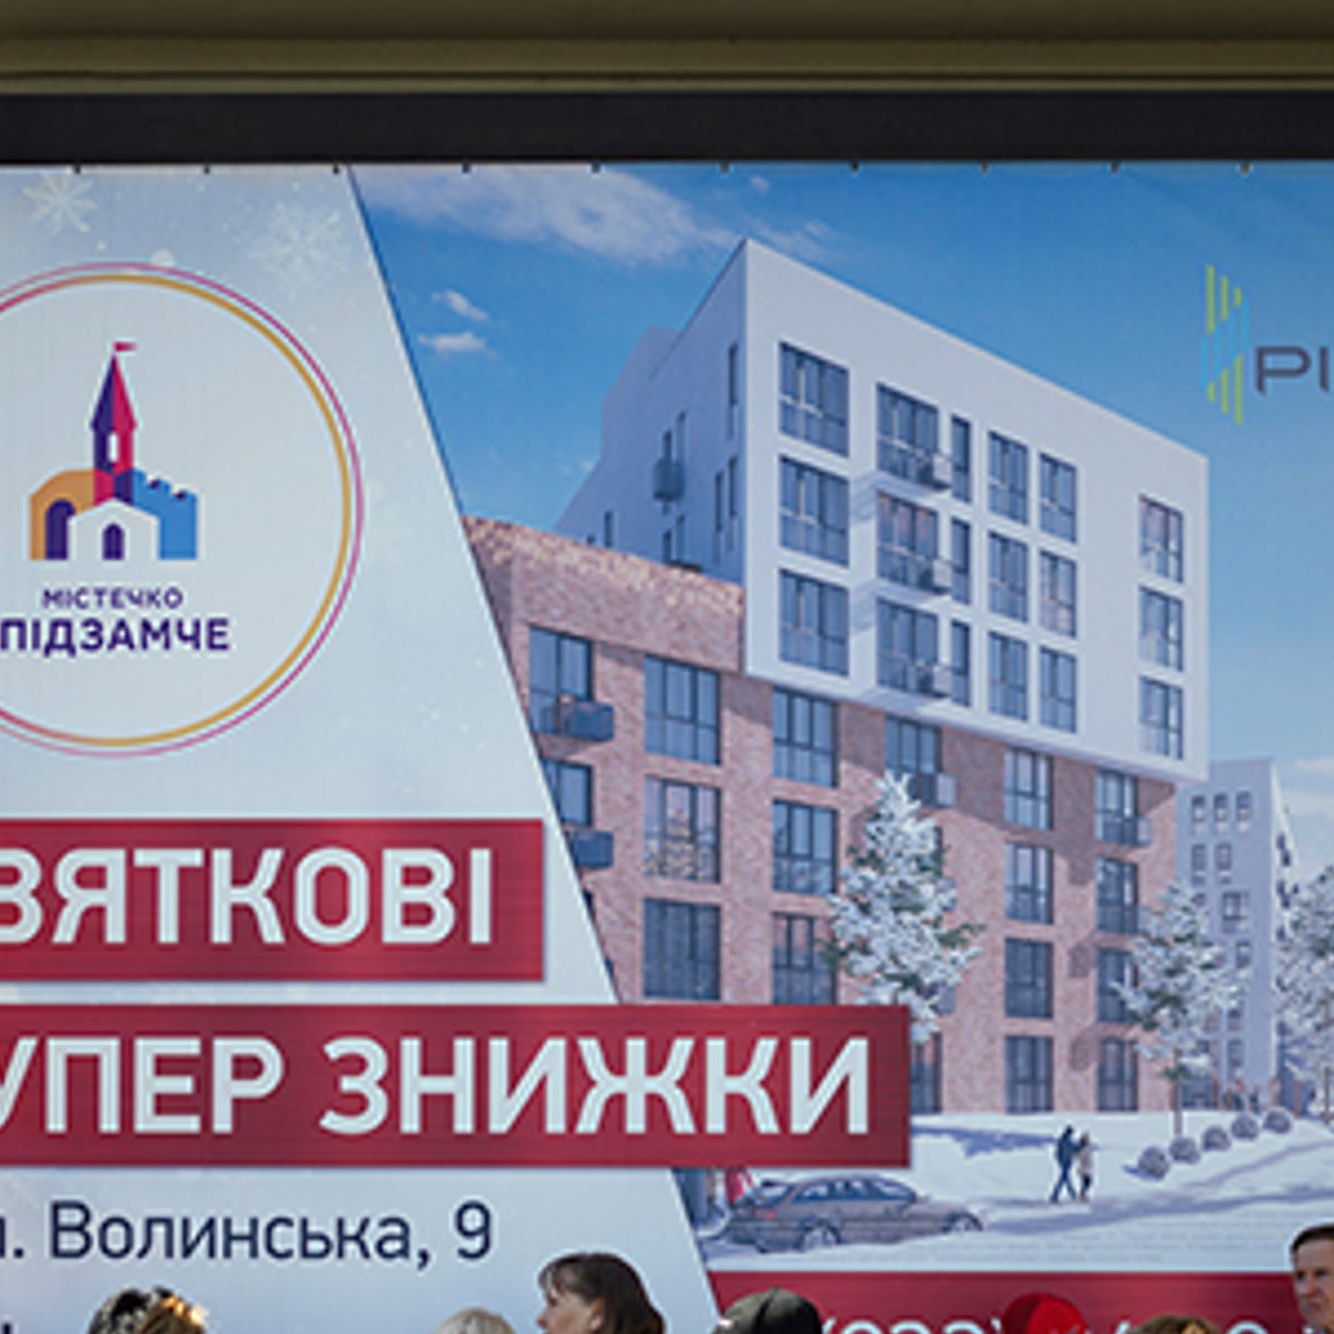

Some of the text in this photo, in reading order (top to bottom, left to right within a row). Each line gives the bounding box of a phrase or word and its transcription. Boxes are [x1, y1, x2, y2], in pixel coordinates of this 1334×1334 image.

[42, 586, 185, 610] МІСТЕЧКО
[0, 617, 230, 658] ПІДЗАМЧЕ
[318, 1035, 870, 1137] ЗНИЖКИ
[51, 1200, 431, 1270] Волинська,
[455, 1200, 493, 1260] 9
